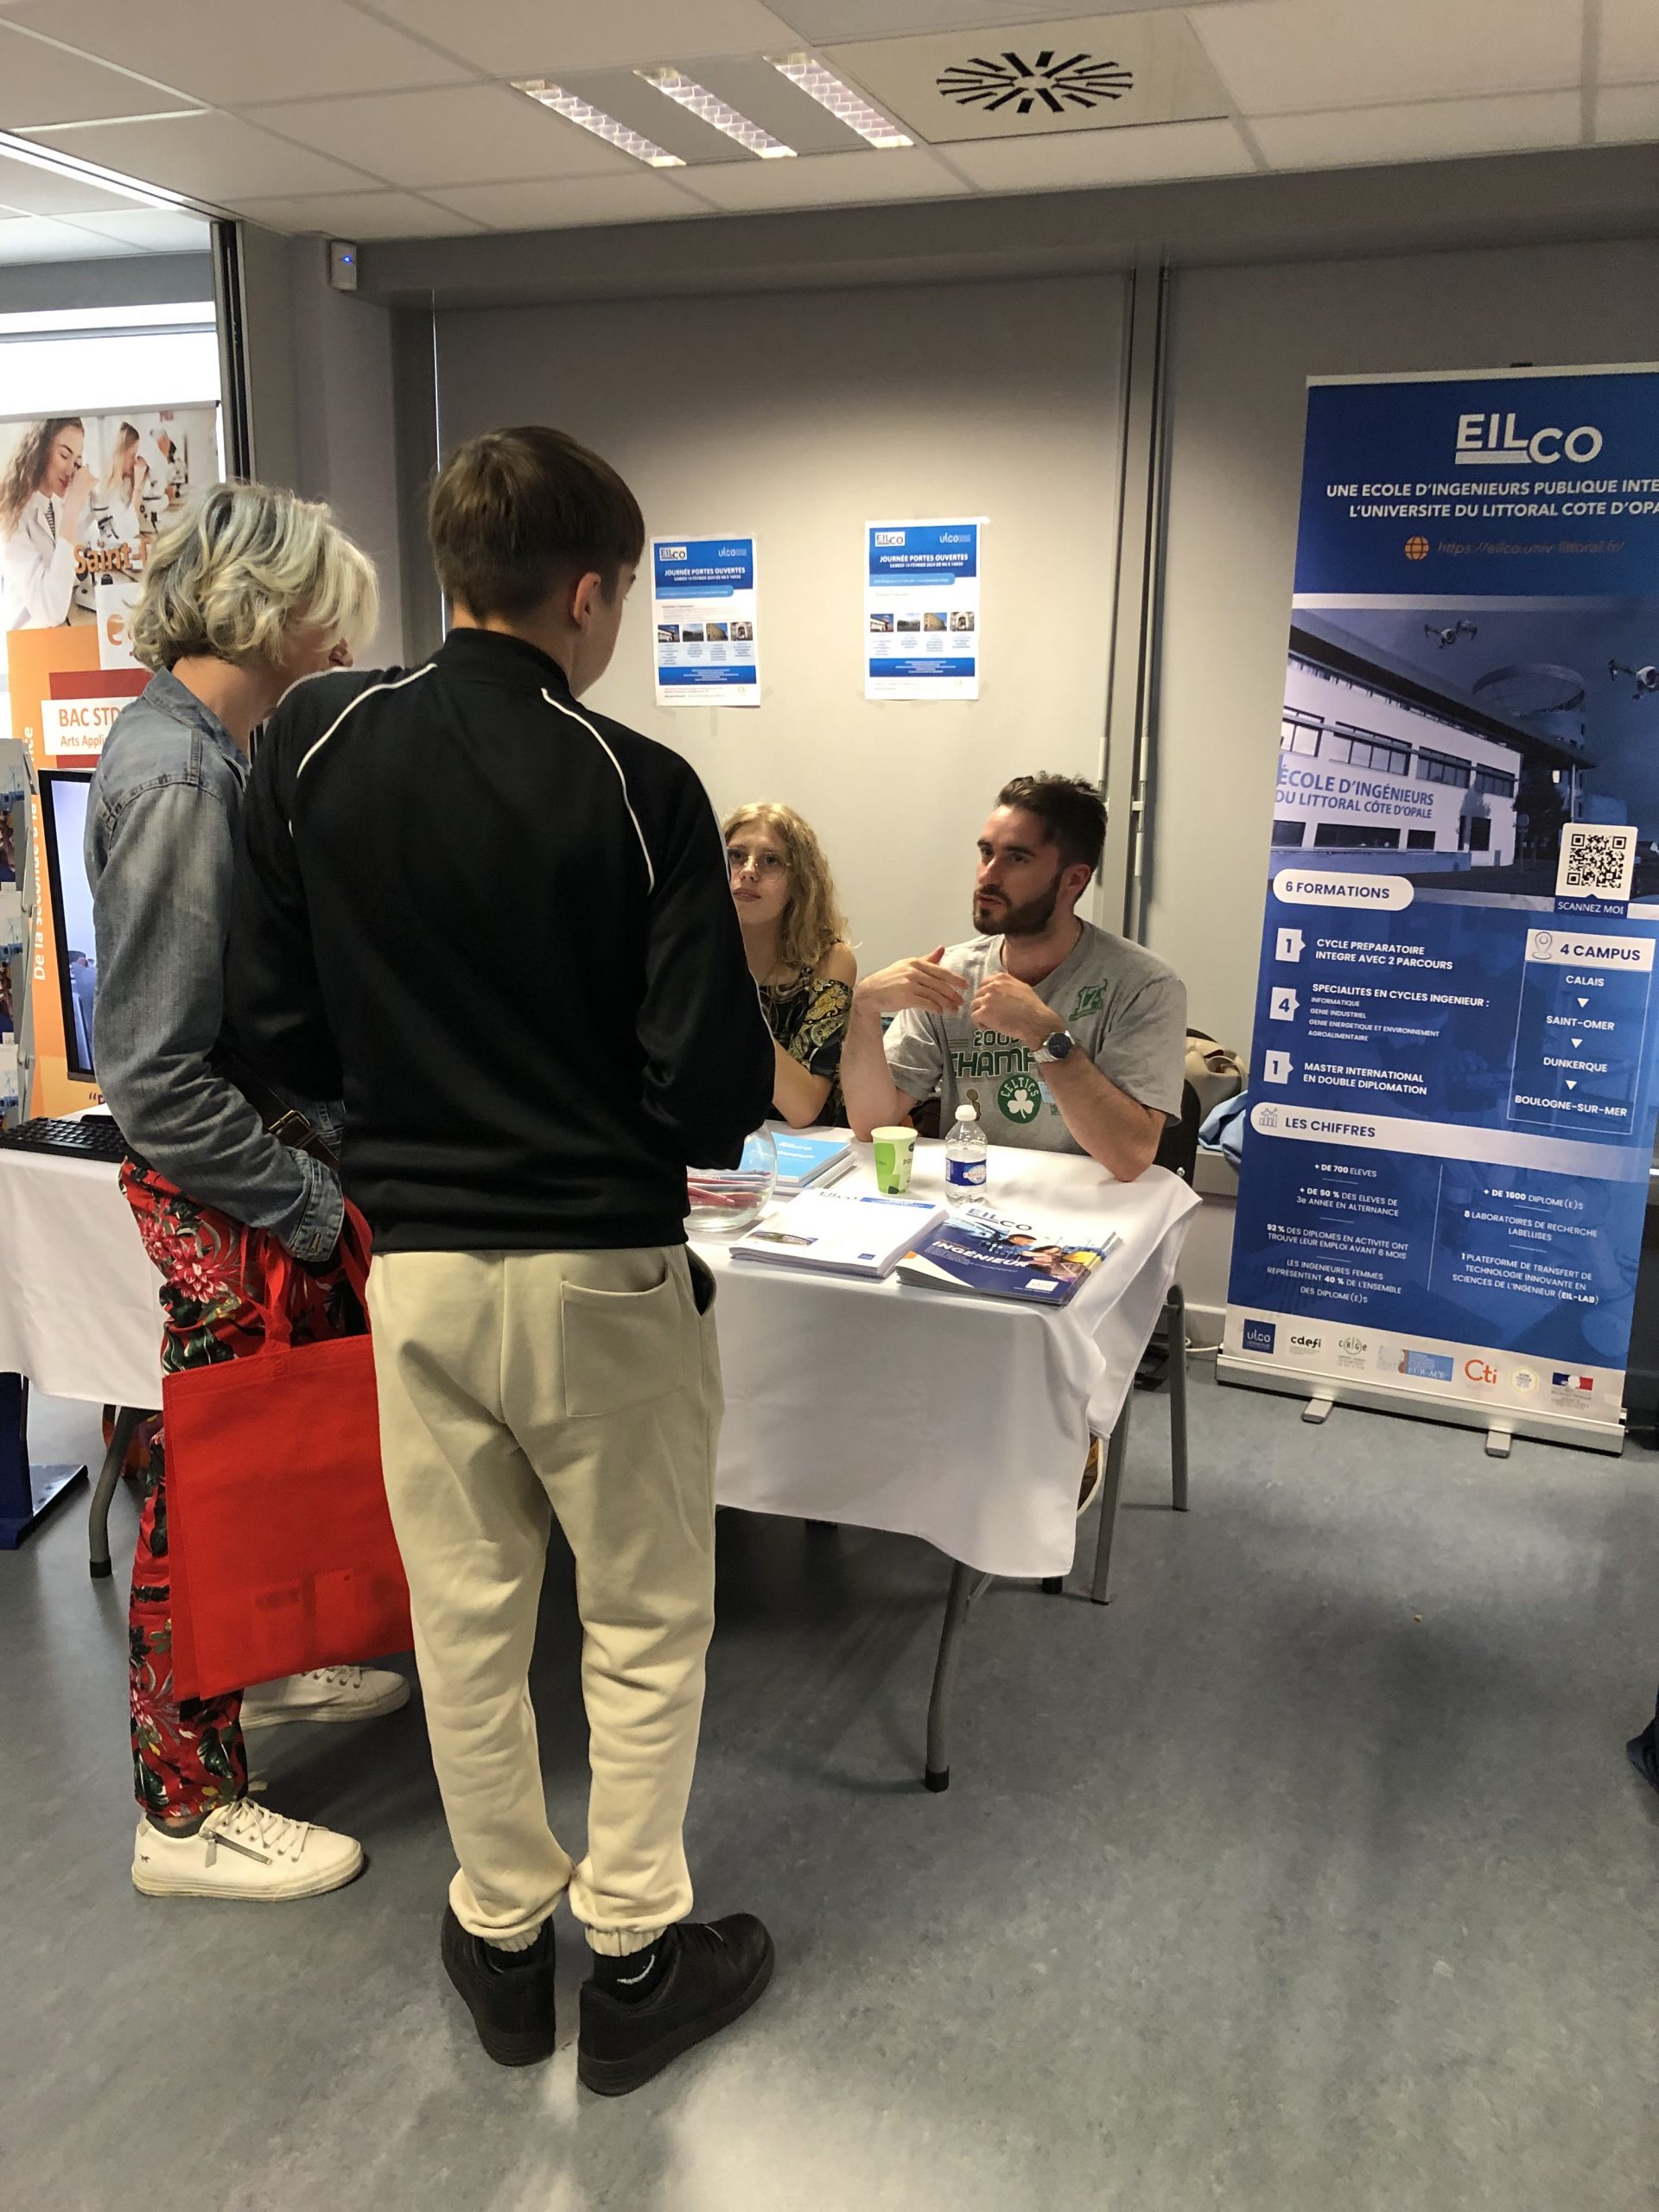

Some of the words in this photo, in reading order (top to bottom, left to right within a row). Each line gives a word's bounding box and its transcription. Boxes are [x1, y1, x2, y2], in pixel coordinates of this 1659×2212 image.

[1455, 412, 1603, 464] EILCO
[1326, 485, 1358, 497] UNE
[1362, 484, 1412, 497] ECOLE
[1534, 480, 1618, 495] PUBLIQUE
[1621, 479, 1659, 493] INTE
[1455, 504, 1478, 518] DU
[1482, 503, 1559, 518] LITTORAL
[1562, 502, 1606, 516] COTE
[935, 553, 968, 562] OUVERTES
[59, 707, 90, 727] BAC
[60, 735, 80, 747] Arts
[1299, 791, 1361, 811] LITTORAL
[1363, 800, 1392, 815] CÔTE
[1285, 881, 1294, 892] 6
[1296, 882, 1390, 899] FORMATIONS
[1558, 901, 1601, 912] SCANNEZ
[1603, 905, 1624, 914] MOI
[1285, 938, 1292, 954] 1
[1316, 938, 1348, 950] CYCLE
[1351, 940, 1425, 955] PREPARATOIRE
[1560, 944, 1570, 955] 4
[1573, 945, 1641, 961] CAMPUS
[35, 954, 46, 980] De
[1315, 950, 1356, 963] INTEGRE
[1357, 953, 1386, 964] AVEC
[1388, 957, 1395, 965] 2
[1396, 957, 1453, 970] PARCOURS
[1565, 975, 1605, 987] CALAIS
[1311, 996, 1361, 1007] INFORMATIQUE
[1312, 983, 1372, 997] SPECIALITES
[1374, 988, 1388, 998] EN
[1389, 989, 1428, 1001] CYCLES
[1430, 993, 1484, 1007] INGENIEUR
[1278, 998, 1290, 1012] 4
[1310, 1007, 1329, 1016] GENIE
[1330, 1009, 1367, 1019] INDUSTRIEL
[1308, 1019, 1328, 1027] GENIE
[1329, 1020, 1373, 1032] ENERGETIQUE
[1382, 1026, 1440, 1037] ENVIRONNEMENT
[1546, 1015, 1615, 1031] SAINT-OMER
[1307, 1030, 1369, 1042] AGROALIMENTAIRE
[1272, 1060, 1279, 1075] 1
[1304, 1062, 1344, 1074] MASTER
[1345, 1066, 1424, 1083] INTERNATIONAL
[1543, 1057, 1608, 1072] DUNKERQUE
[1000, 1077, 1039, 1097] CELTICS
[1303, 1074, 1317, 1084] EN
[1318, 1075, 1356, 1088] DOUBLE
[1357, 1079, 1427, 1095] DIPLOMATION
[1515, 1095, 1628, 1117] BOULOGNE-SUR-MER
[1285, 1117, 1307, 1129] LES
[1311, 1120, 1376, 1138] CHIFFRES
[1333, 1165, 1349, 1173] 700
[1350, 1168, 1377, 1177] ELEVES
[1308, 1198, 1334, 1208] ANNEE
[1336, 1201, 1347, 1210] EN
[1348, 1204, 1399, 1217] ALTERNANCE
[1341, 1192, 1357, 1201] DES
[1358, 1195, 1386, 1205] ELEVES
[1491, 1189, 1503, 1198] DE
[1528, 1194, 1584, 1211] DIPLOME(E)S
[1471, 1211, 1533, 1227] LABORATOIRES
[1534, 1221, 1546, 1230] DE
[1547, 1223, 1599, 1238] RECHERCHE
[1286, 1226, 1301, 1236] DES
[1303, 1229, 1341, 1241] DIPLOMES
[1355, 1236, 1390, 1249] ACTIVITE
[1391, 1242, 1409, 1251] ONT
[1508, 1227, 1553, 1242] LABELLISES
[931, 1241, 1030, 1268] INGÉNIEUR
[1268, 1232, 1298, 1243] TROUVE
[1299, 1237, 1318, 1247] LEUR
[1319, 1240, 1348, 1251] EMPLOI
[1349, 1244, 1376, 1255] AVANT
[1385, 1250, 1407, 1260] MOIS
[1267, 1267, 1323, 1281] REPRESENTENT
[1287, 1259, 1300, 1268] LES
[1300, 1262, 1351, 1275] INGENIEURES
[1351, 1268, 1383, 1281] FEMMES
[1466, 1253, 1518, 1268] PLATEFORME
[1520, 1262, 1531, 1270] DE
[1533, 1263, 1580, 1279] TRANSFERT
[1580, 1272, 1592, 1281] DE
[1465, 1264, 1523, 1281] TECHNOLOGIE
[1524, 1273, 1574, 1289] INNOVANTE
[1574, 1282, 1586, 1291] EN
[1300, 1286, 1315, 1295] DES
[1452, 1273, 1493, 1287] SCIENCES
[1494, 1281, 1505, 1289] DE
[1557, 1290, 1599, 1306] (EIL-LAB)
[1247, 1329, 1271, 1343] ulco
[1290, 1336, 1322, 1349] cdefi
[1464, 1359, 1497, 1384] Cti
